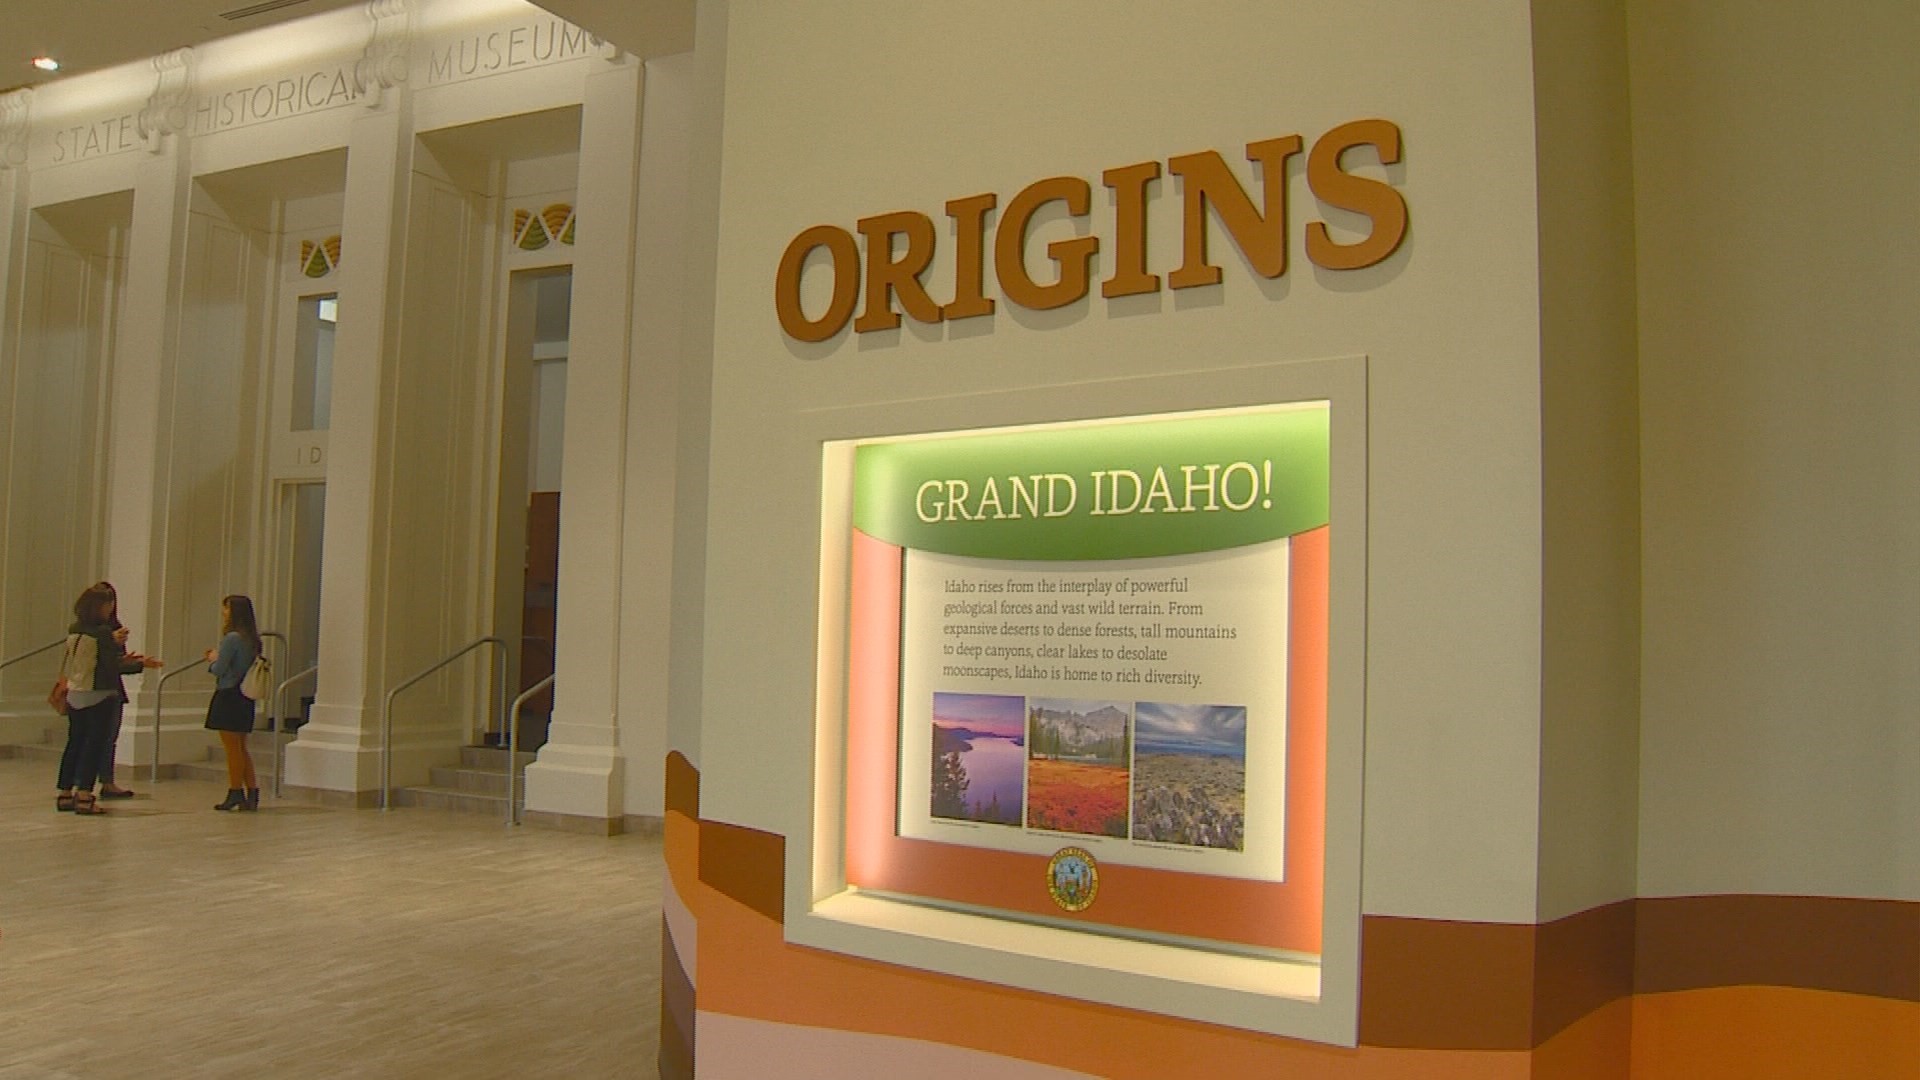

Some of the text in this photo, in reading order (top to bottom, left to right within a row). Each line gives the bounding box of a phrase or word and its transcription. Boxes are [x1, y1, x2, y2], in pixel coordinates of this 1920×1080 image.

[53, 115, 132, 162] STATE
[428, 21, 587, 84] MUSEUM
[775, 119, 1409, 343] ORIGINS
[915, 459, 1272, 522] GRAND IDAHO!
[944, 577, 1188, 597] Idaho rises from the interplay of powerful
[943, 599, 1203, 618] geological forces and vast wild terrain. From
[943, 621, 1237, 639] expansive deserts to dense forests, tall mountains
[943, 641, 1168, 660] to deep canyons, clear lakes to desolate
[943, 665, 1202, 689] moonscapes, Idaho is home to rich diversity.
